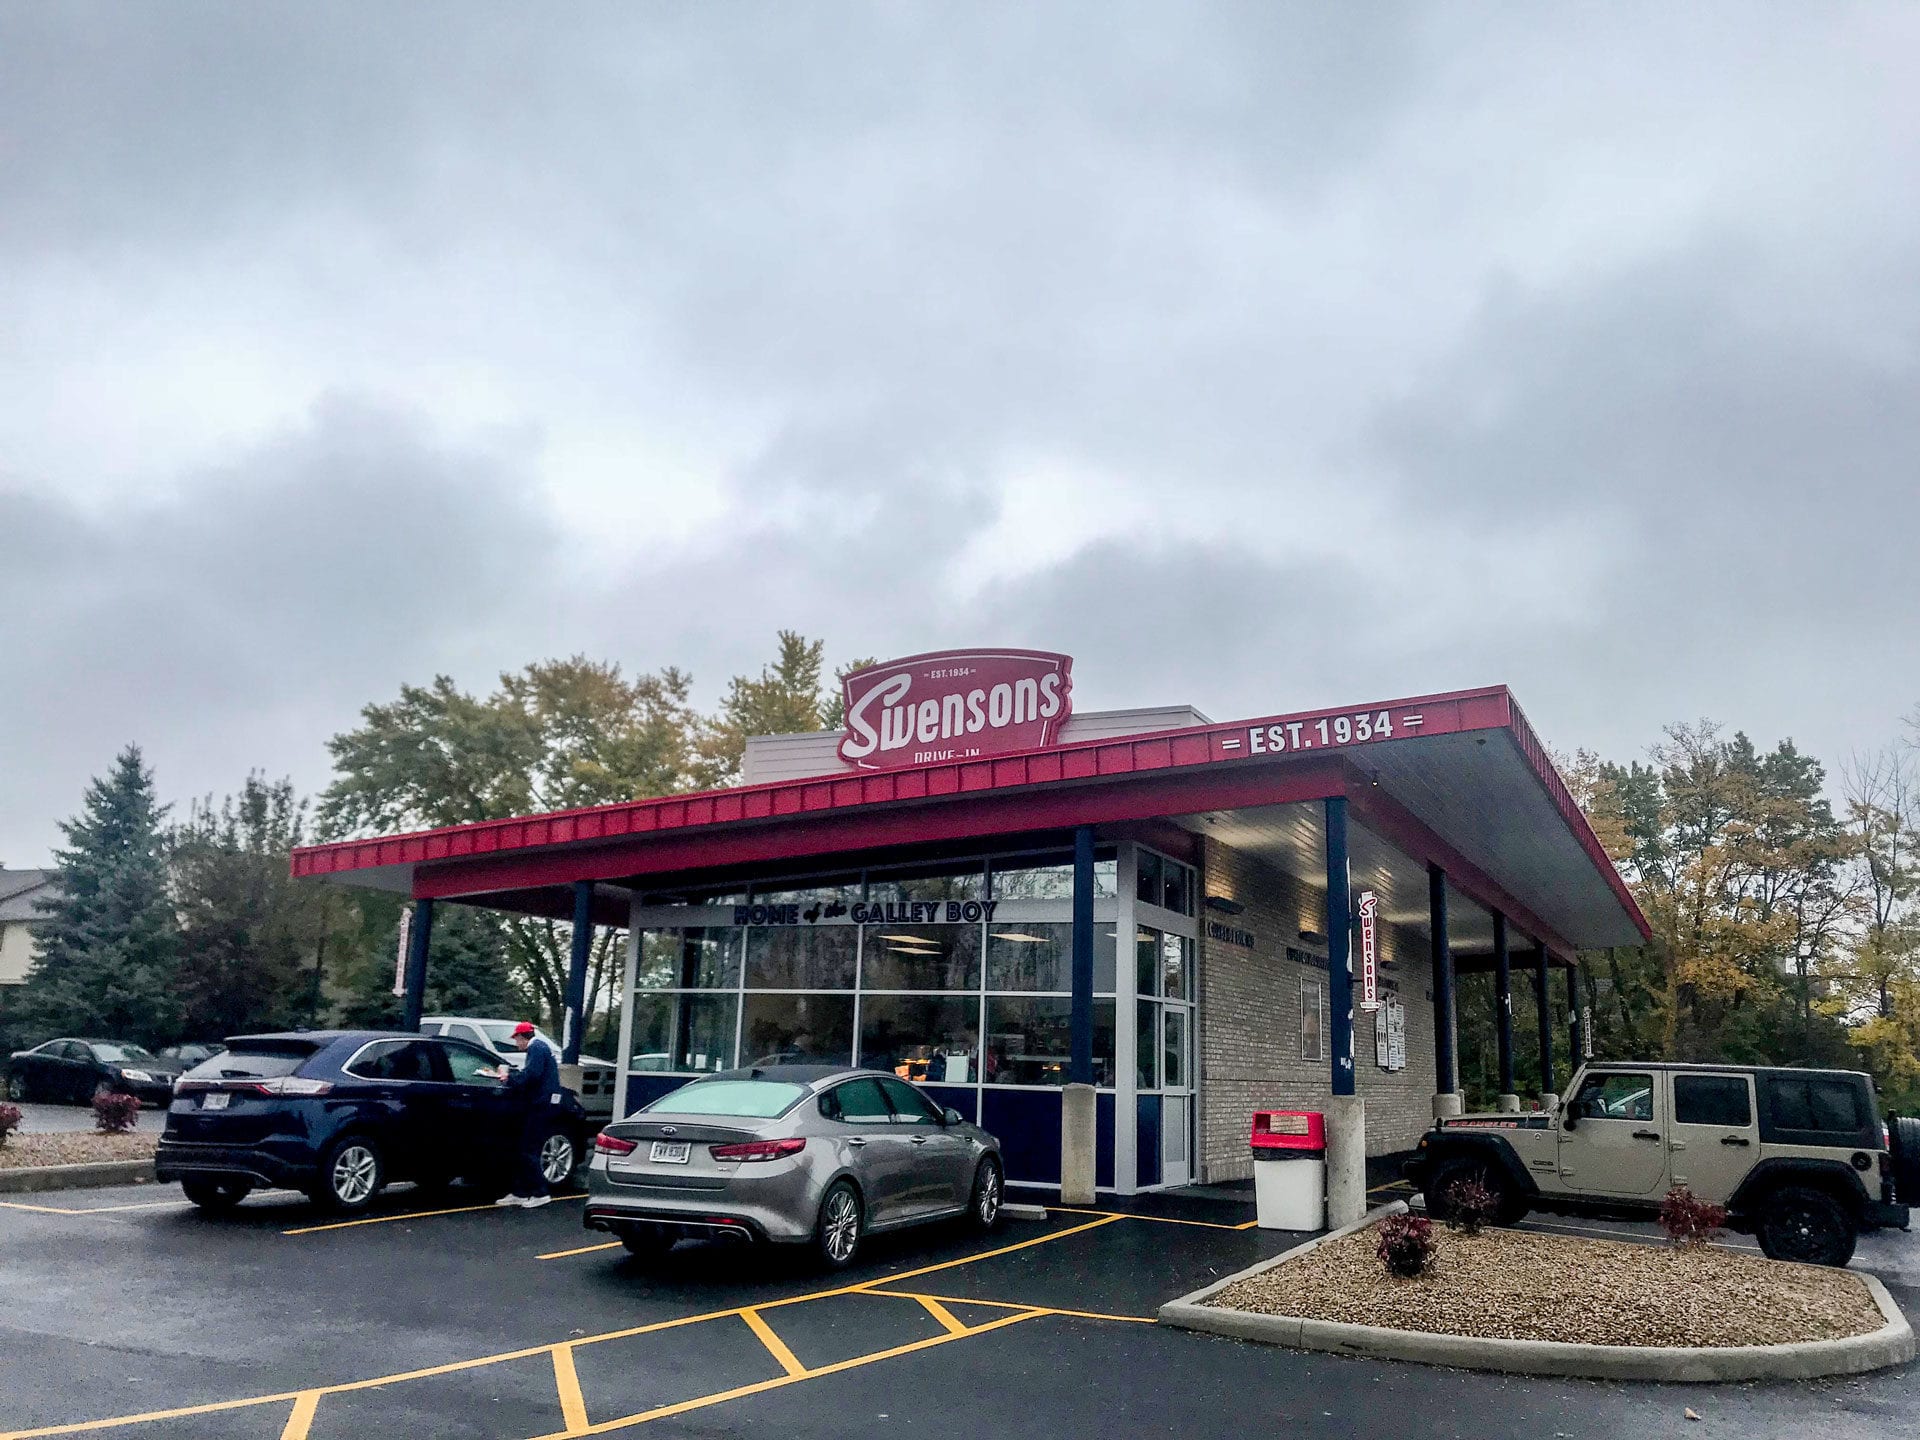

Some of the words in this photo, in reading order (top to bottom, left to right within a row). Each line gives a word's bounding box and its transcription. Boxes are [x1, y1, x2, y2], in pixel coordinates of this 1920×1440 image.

[949, 667, 969, 677] 1934
[841, 672, 1062, 758] Swensons
[1314, 710, 1393, 745] 1934
[734, 904, 799, 925] HOME
[803, 901, 822, 923] of
[824, 899, 848, 918] the
[850, 901, 940, 923] GALLEY
[945, 901, 998, 922] BOY
[1361, 898, 1377, 999] Swensons
